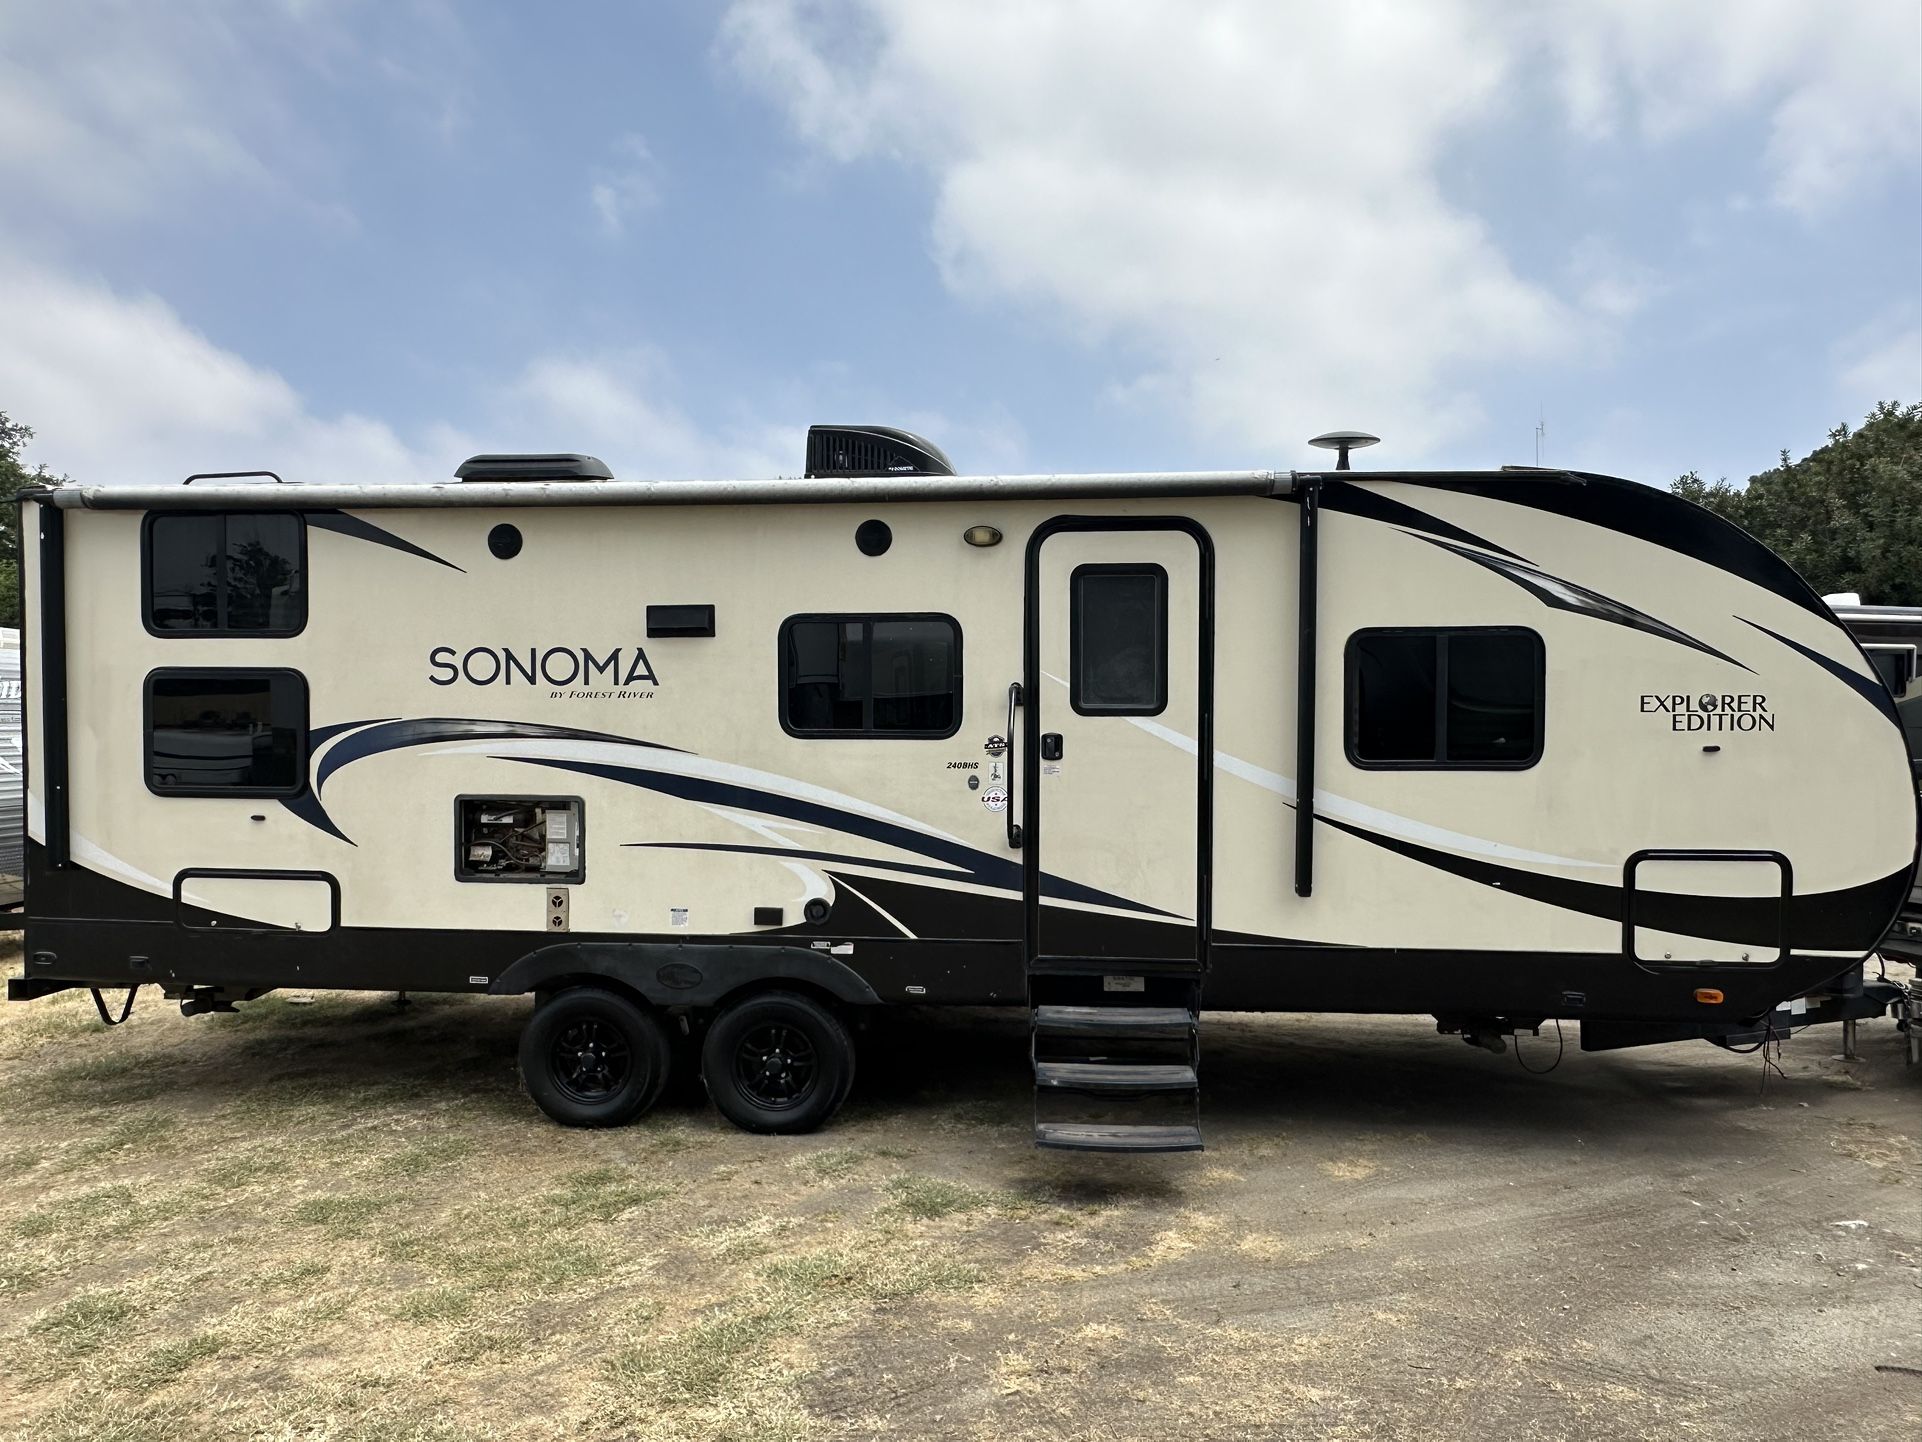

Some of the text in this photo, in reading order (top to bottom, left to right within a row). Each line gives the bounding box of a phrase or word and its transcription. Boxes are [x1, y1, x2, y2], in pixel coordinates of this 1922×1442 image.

[429, 646, 660, 687] SONOMA
[550, 690, 655, 699] BY FOREST RIVER
[1640, 694, 1768, 713] EXPLORER
[1672, 713, 1775, 732] EDITION
[946, 761, 980, 770] 240BHS
